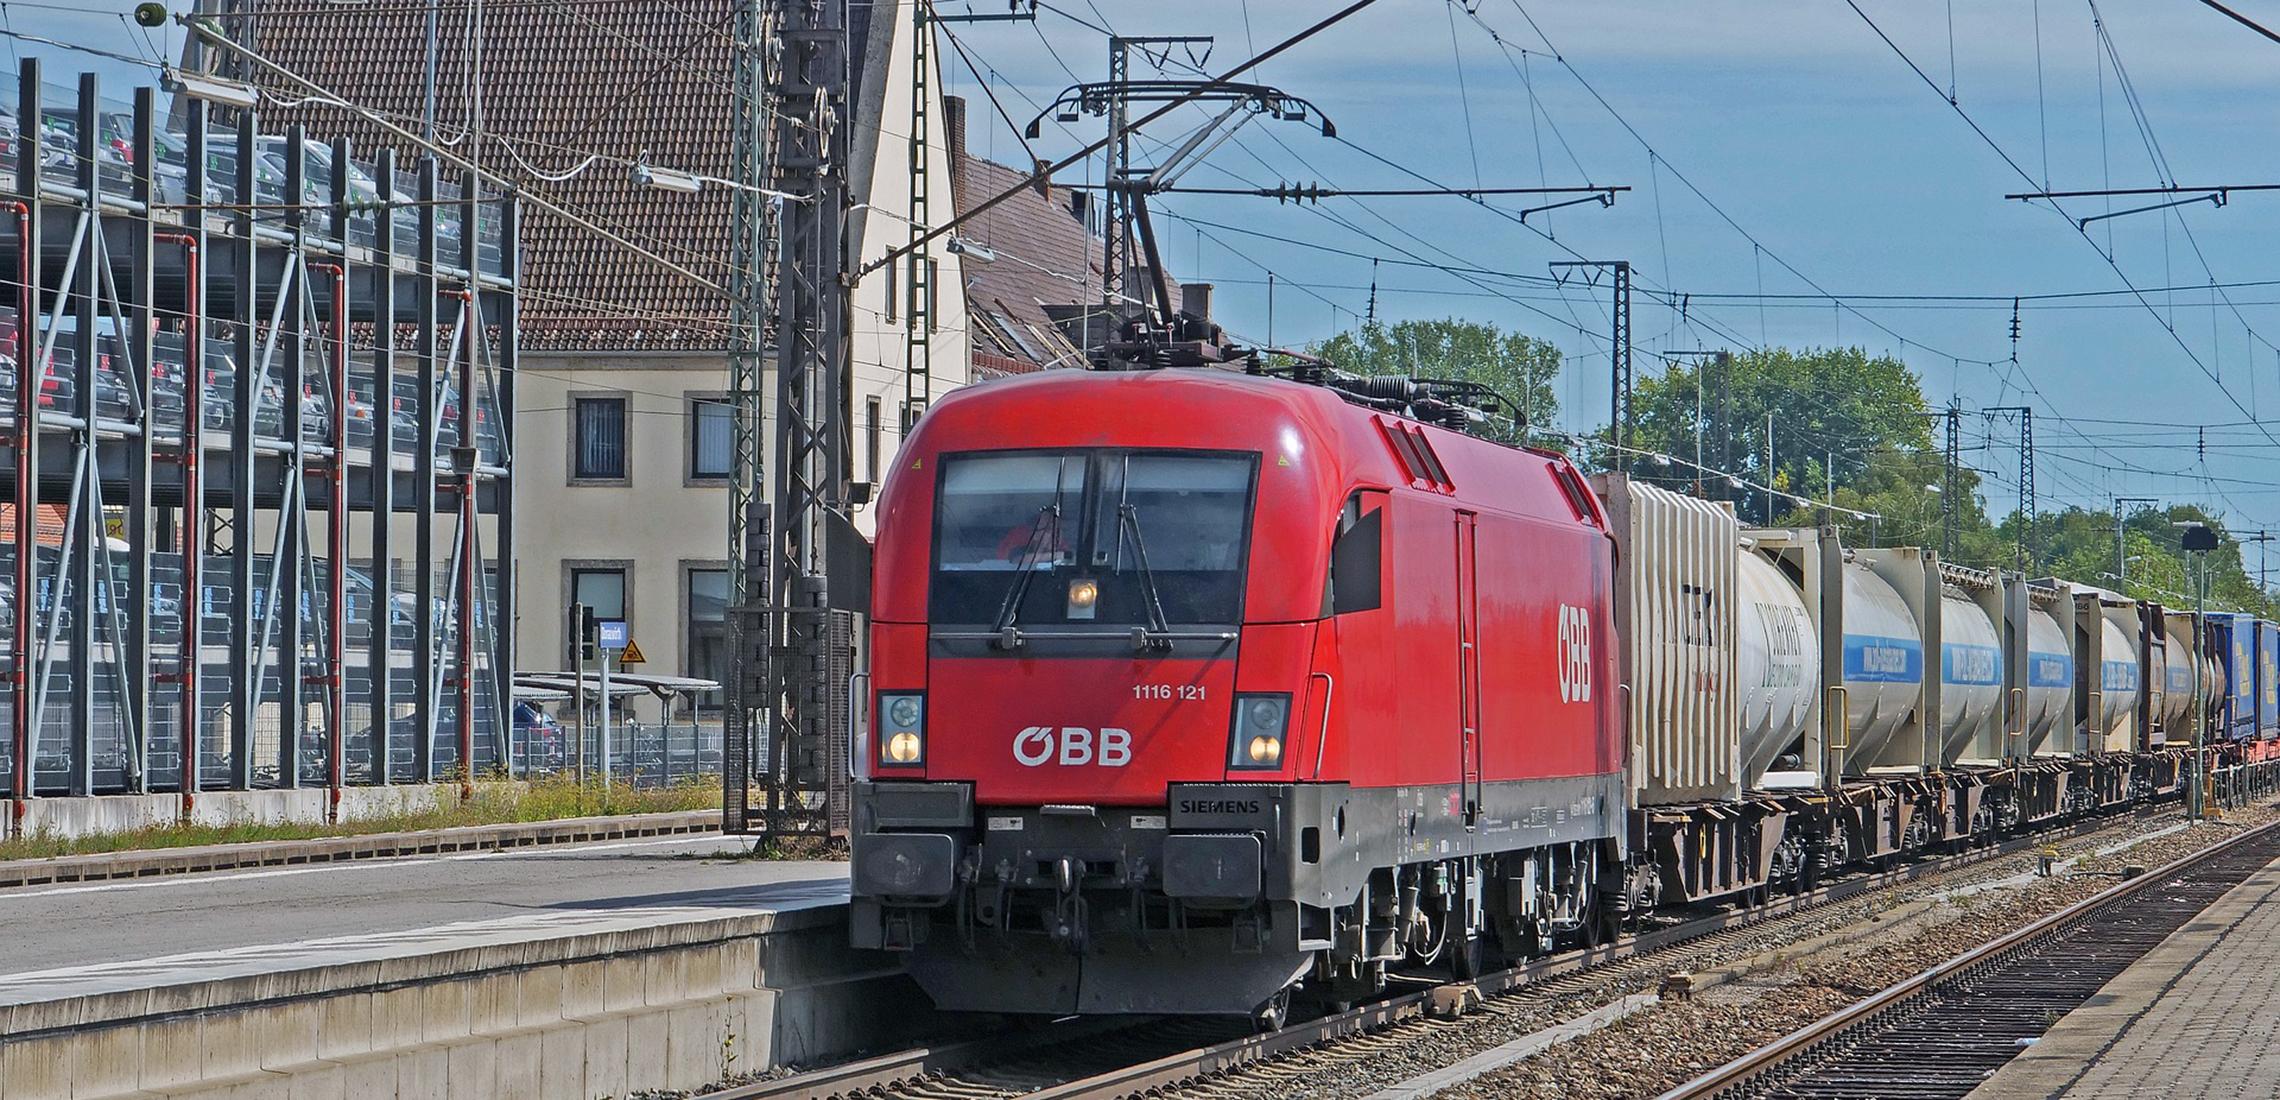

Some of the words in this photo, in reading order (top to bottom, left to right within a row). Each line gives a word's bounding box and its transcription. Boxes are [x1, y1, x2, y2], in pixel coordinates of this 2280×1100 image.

[1558, 603, 1591, 704] ÖBB
[1132, 684, 1171, 699] 1116
[1177, 685, 1206, 700] 121
[1013, 726, 1132, 767] ÖBB
[1180, 800, 1259, 814] SIEMENS
